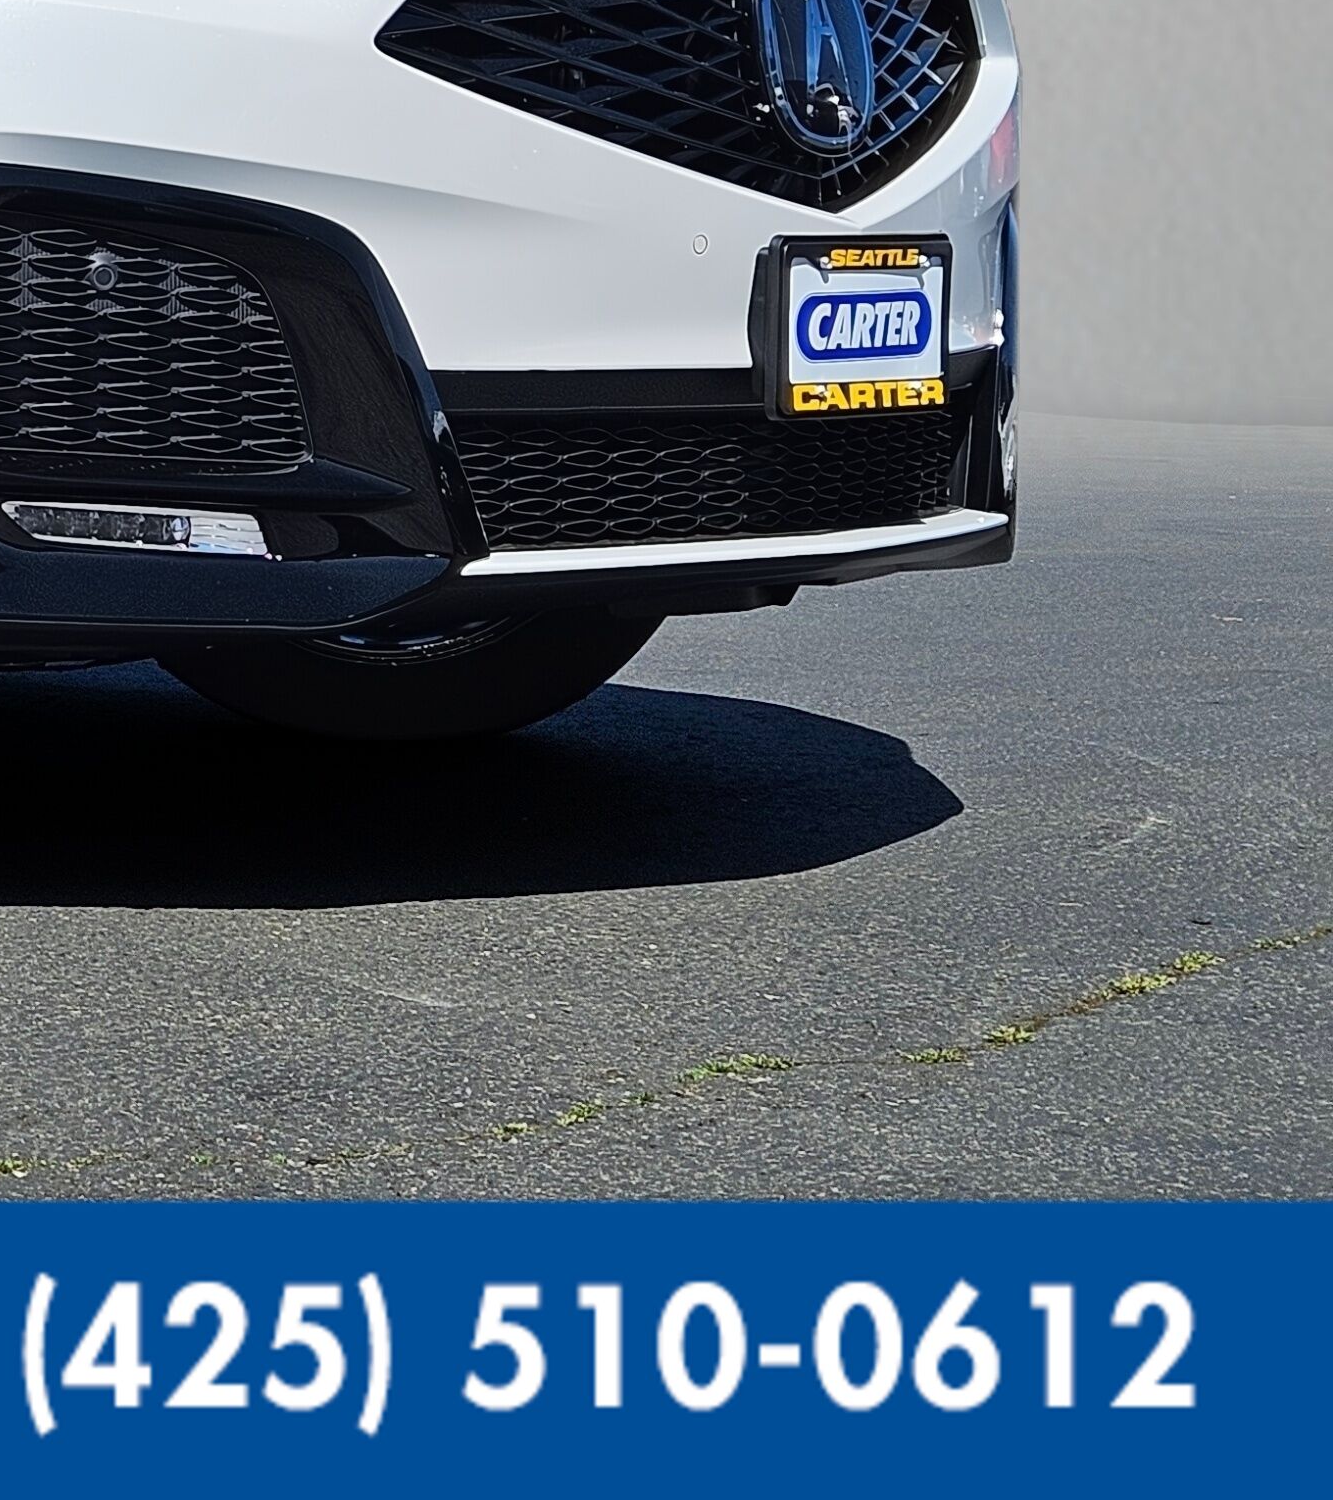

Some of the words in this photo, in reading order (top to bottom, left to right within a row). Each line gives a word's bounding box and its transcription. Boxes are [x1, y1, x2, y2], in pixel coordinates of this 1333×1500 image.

[830, 248, 920, 268] SEATTLE
[807, 300, 921, 351] CARTER
[792, 379, 945, 411] CARTER
